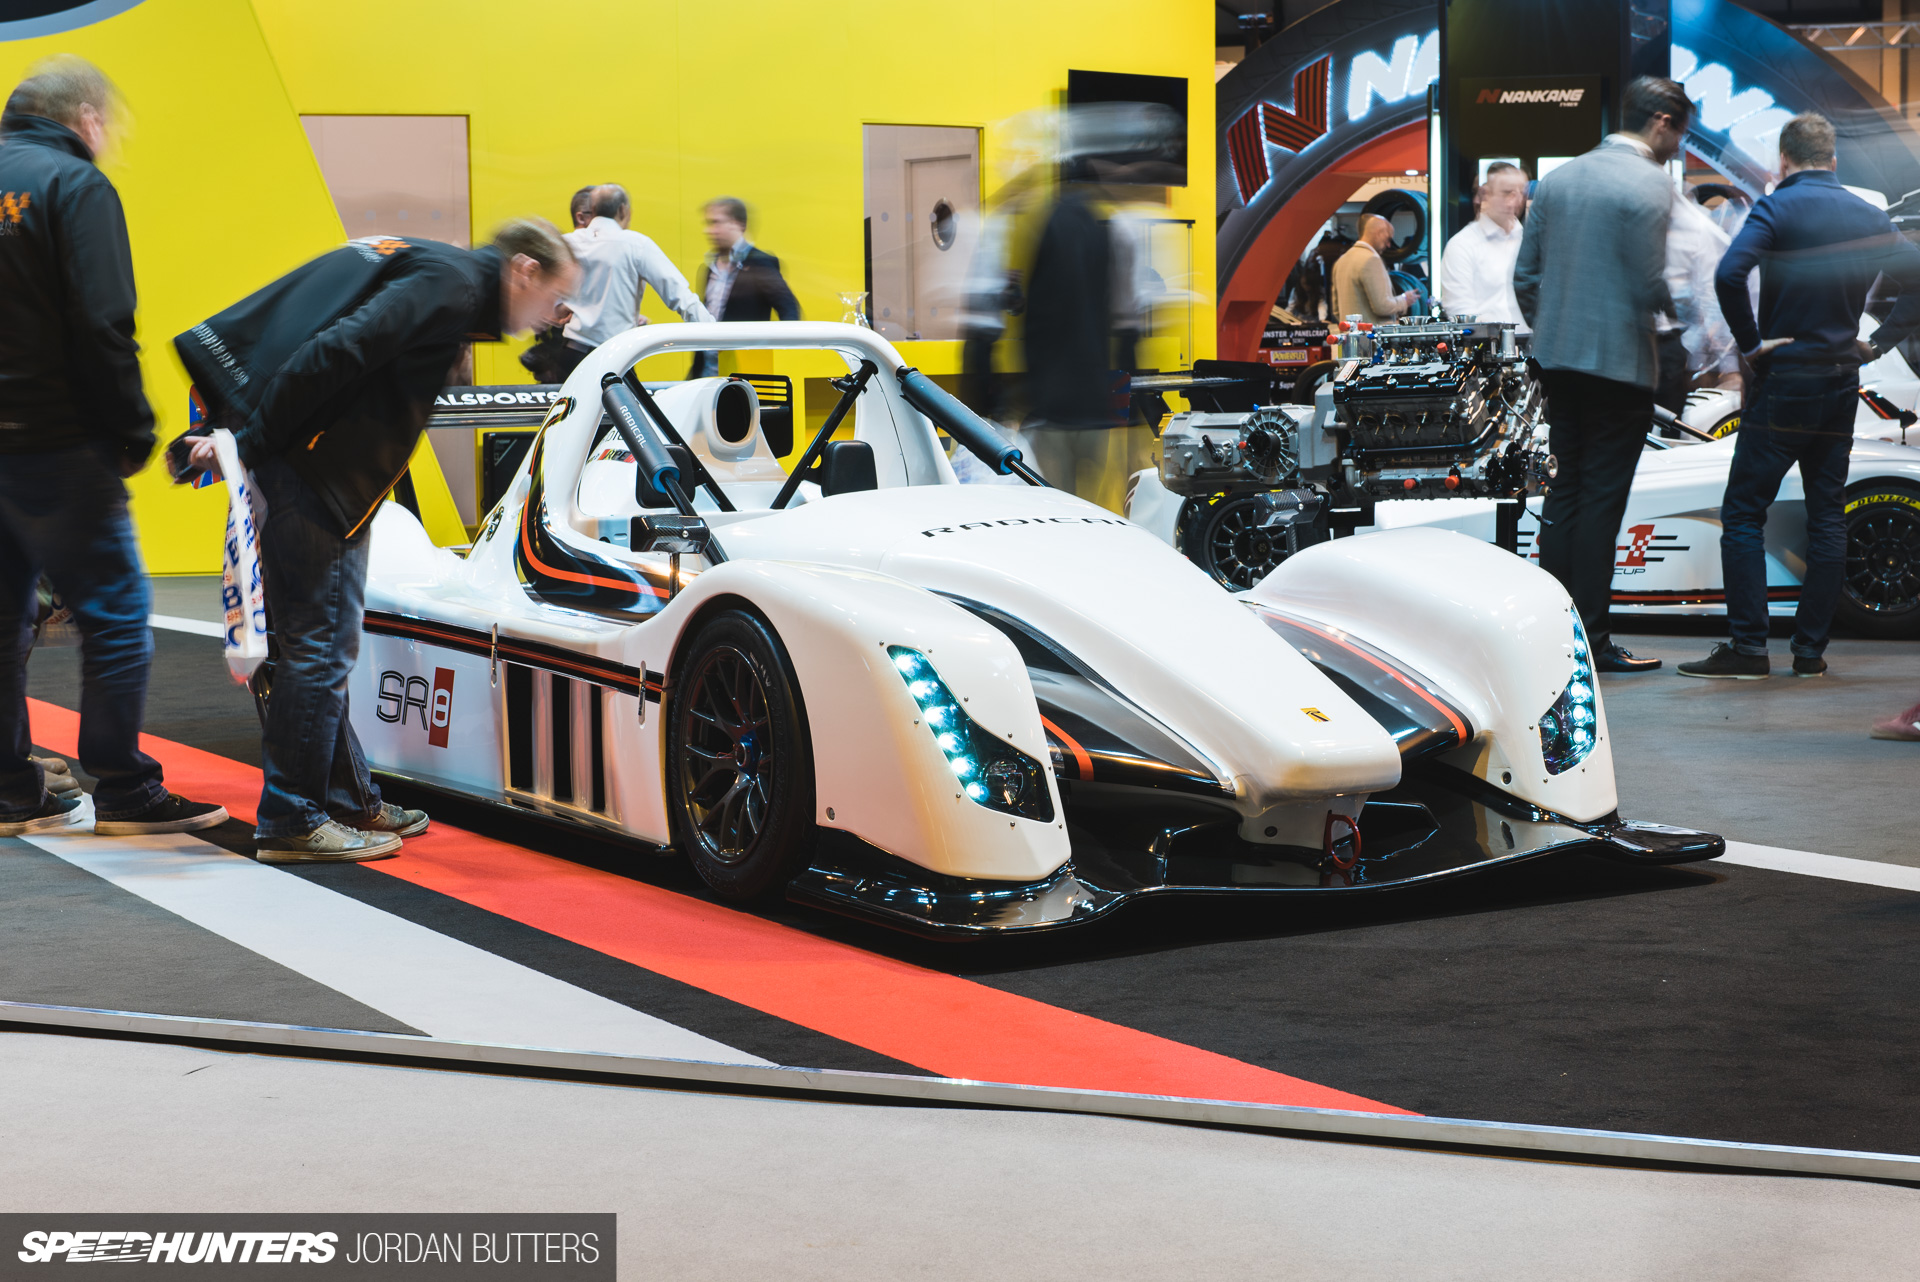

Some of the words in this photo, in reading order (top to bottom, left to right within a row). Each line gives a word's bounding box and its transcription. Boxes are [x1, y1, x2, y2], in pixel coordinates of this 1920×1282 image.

[1499, 89, 1585, 103] NANKANG
[620, 405, 647, 448] RADICAL
[1857, 494, 1917, 507] DUNLOP
[921, 517, 1146, 538] RADICAL
[376, 670, 451, 732] SR8
